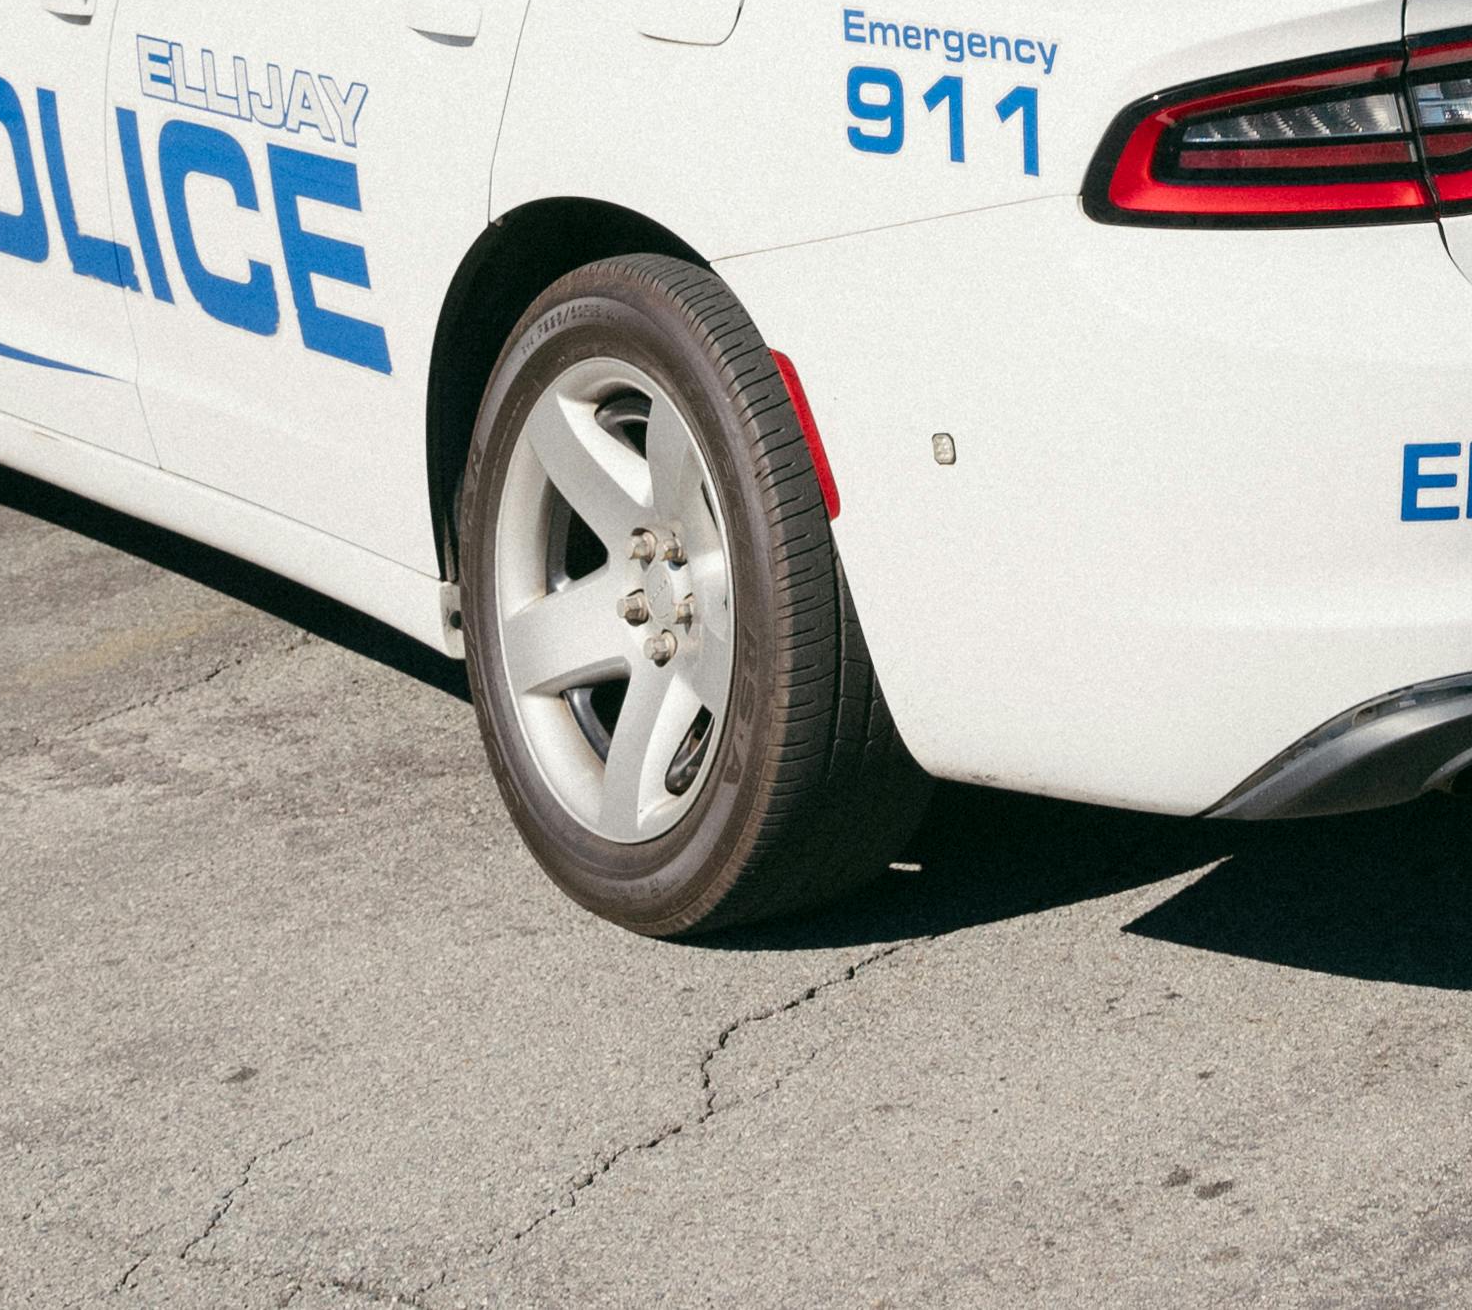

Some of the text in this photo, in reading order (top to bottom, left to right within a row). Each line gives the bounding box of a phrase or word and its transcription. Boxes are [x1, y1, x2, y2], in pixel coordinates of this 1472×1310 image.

[136, 34, 369, 148] ELLIJAY
[843, 8, 1058, 74] Emergency
[846, 65, 1040, 177] 911
